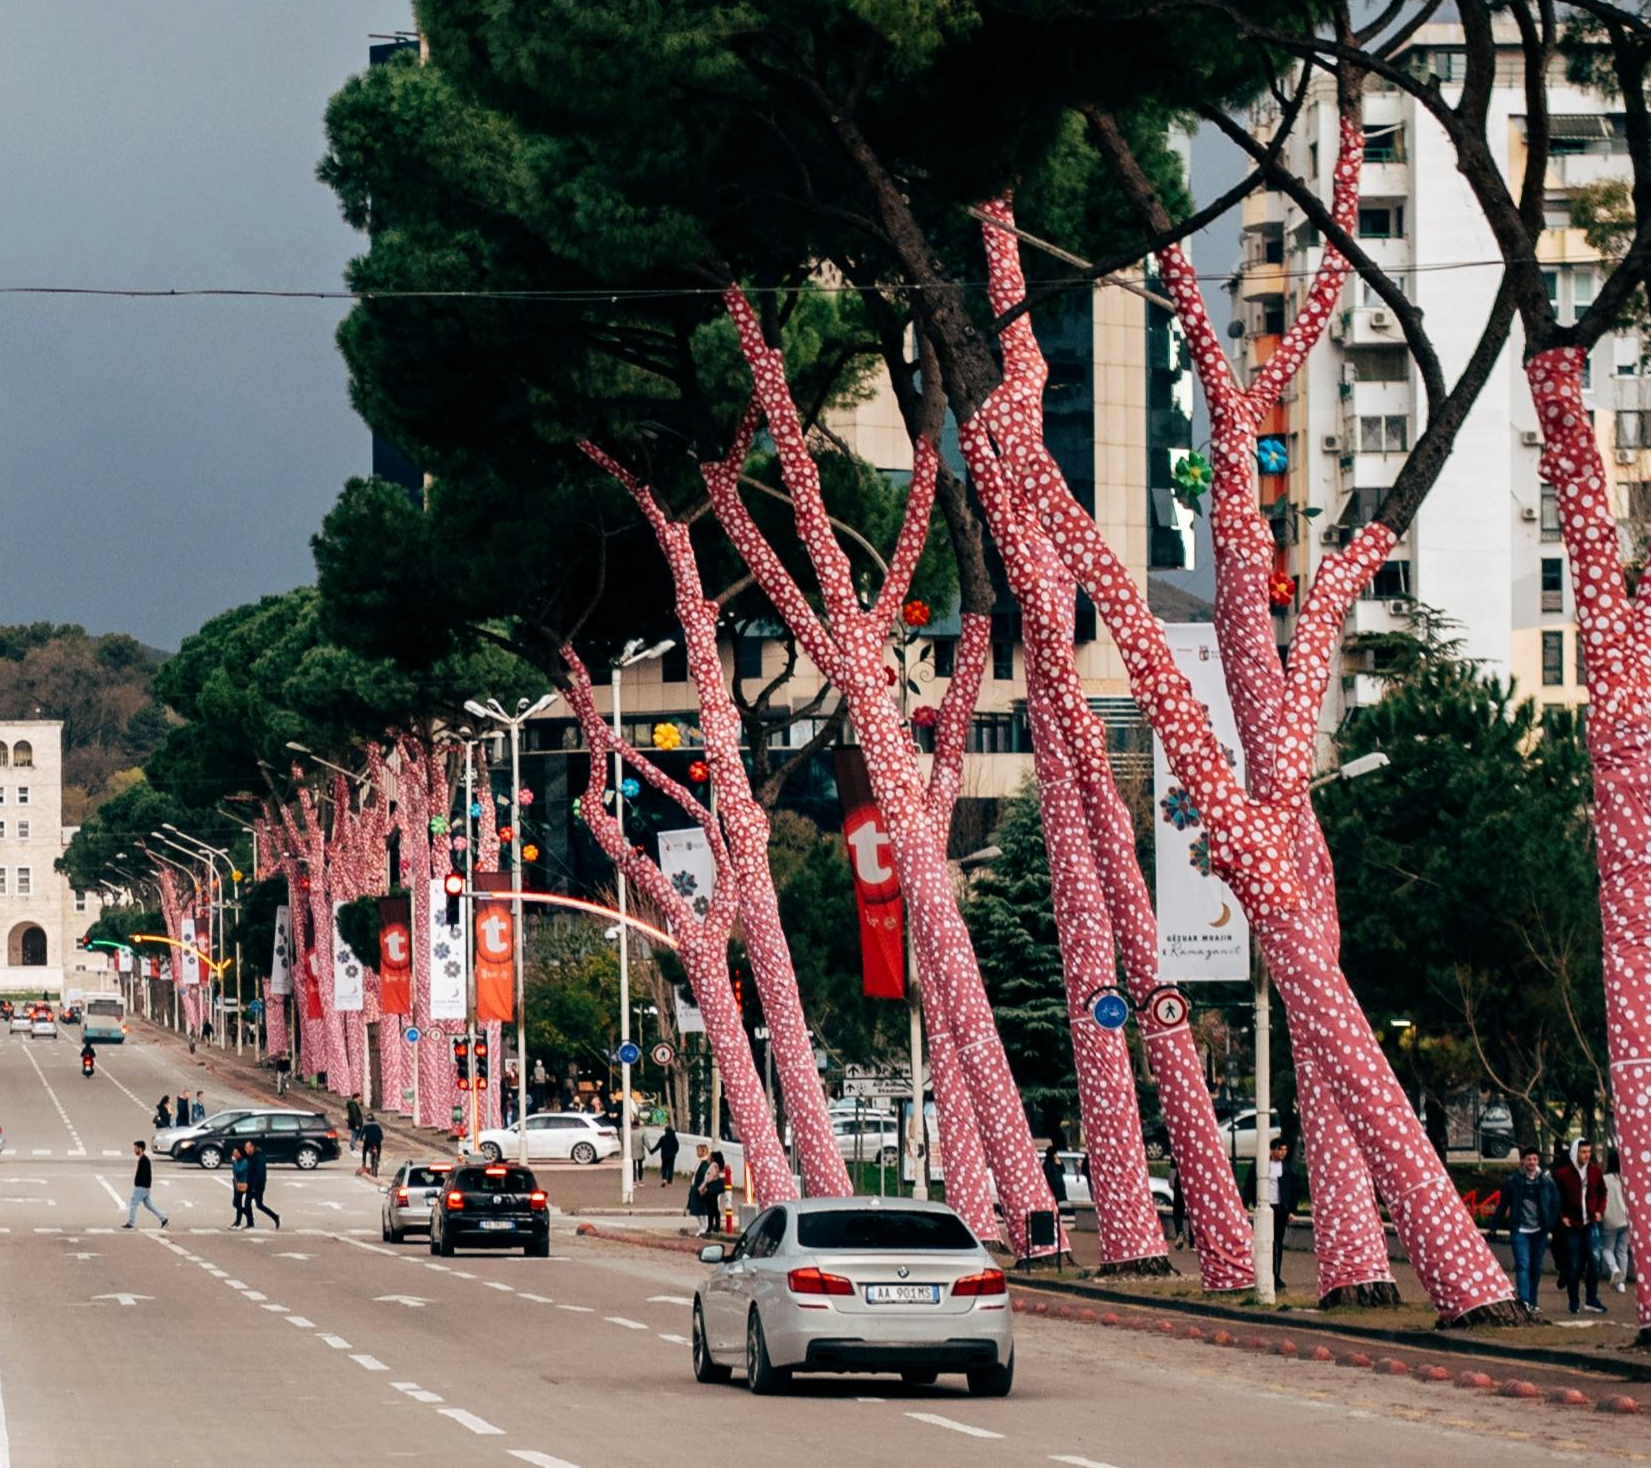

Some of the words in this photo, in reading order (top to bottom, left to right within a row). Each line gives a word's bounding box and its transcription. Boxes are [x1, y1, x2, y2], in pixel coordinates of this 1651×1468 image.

[847, 821, 893, 884] t
[384, 931, 406, 962] t
[481, 915, 508, 953] t
